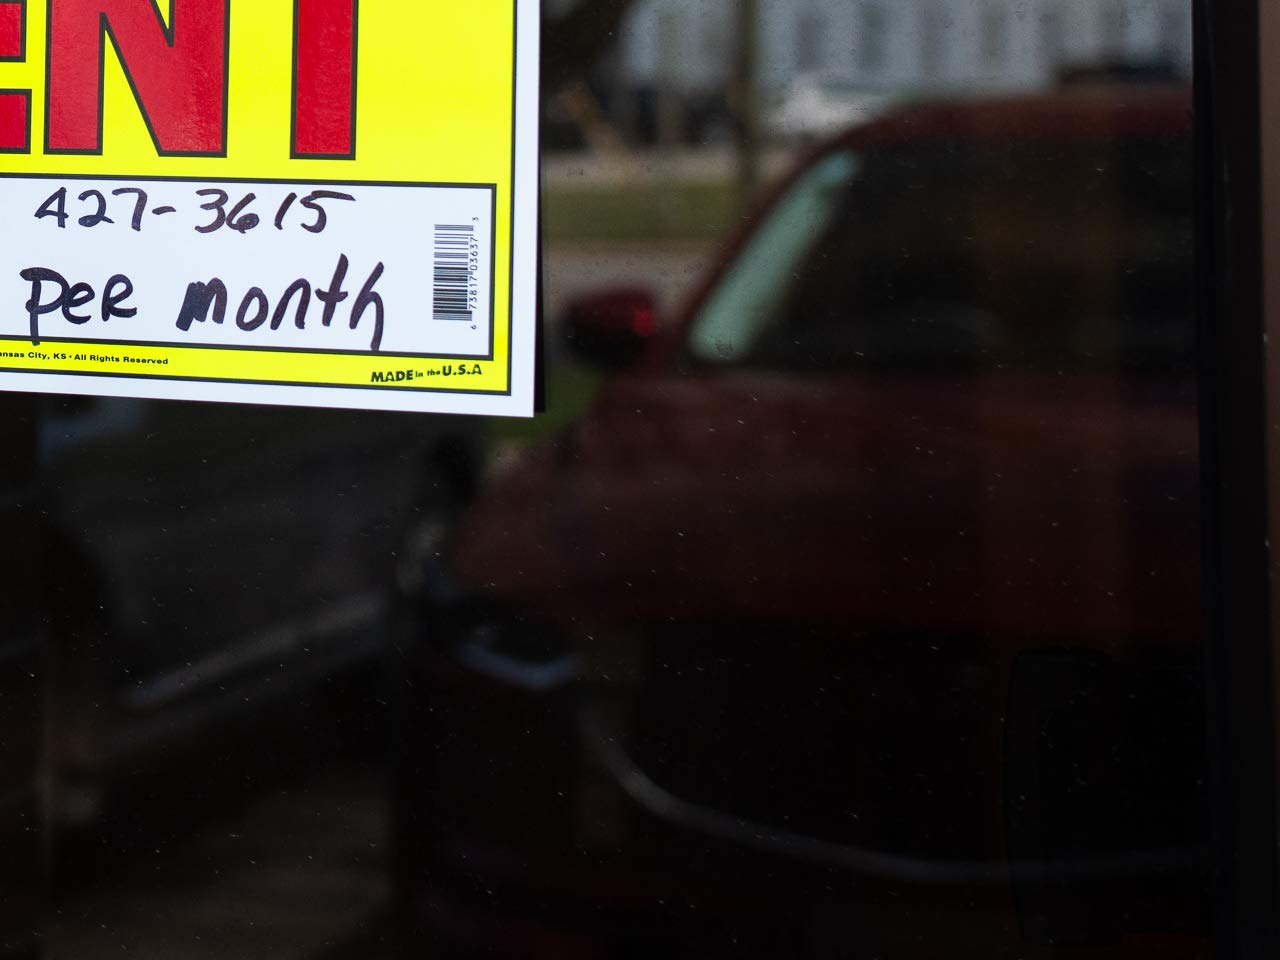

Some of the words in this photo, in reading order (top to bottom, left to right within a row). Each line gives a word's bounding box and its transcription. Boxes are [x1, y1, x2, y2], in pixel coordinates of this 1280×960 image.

[469, 236, 479, 271] 03637
[176, 253, 384, 351] month
[468, 275, 478, 310] 73817
[28, 351, 50, 360] City,
[53, 352, 67, 360] KS
[74, 353, 87, 361] All
[89, 354, 120, 363] Rights
[123, 356, 169, 365] Reserved
[371, 370, 414, 382] MADE
[427, 368, 441, 376] the
